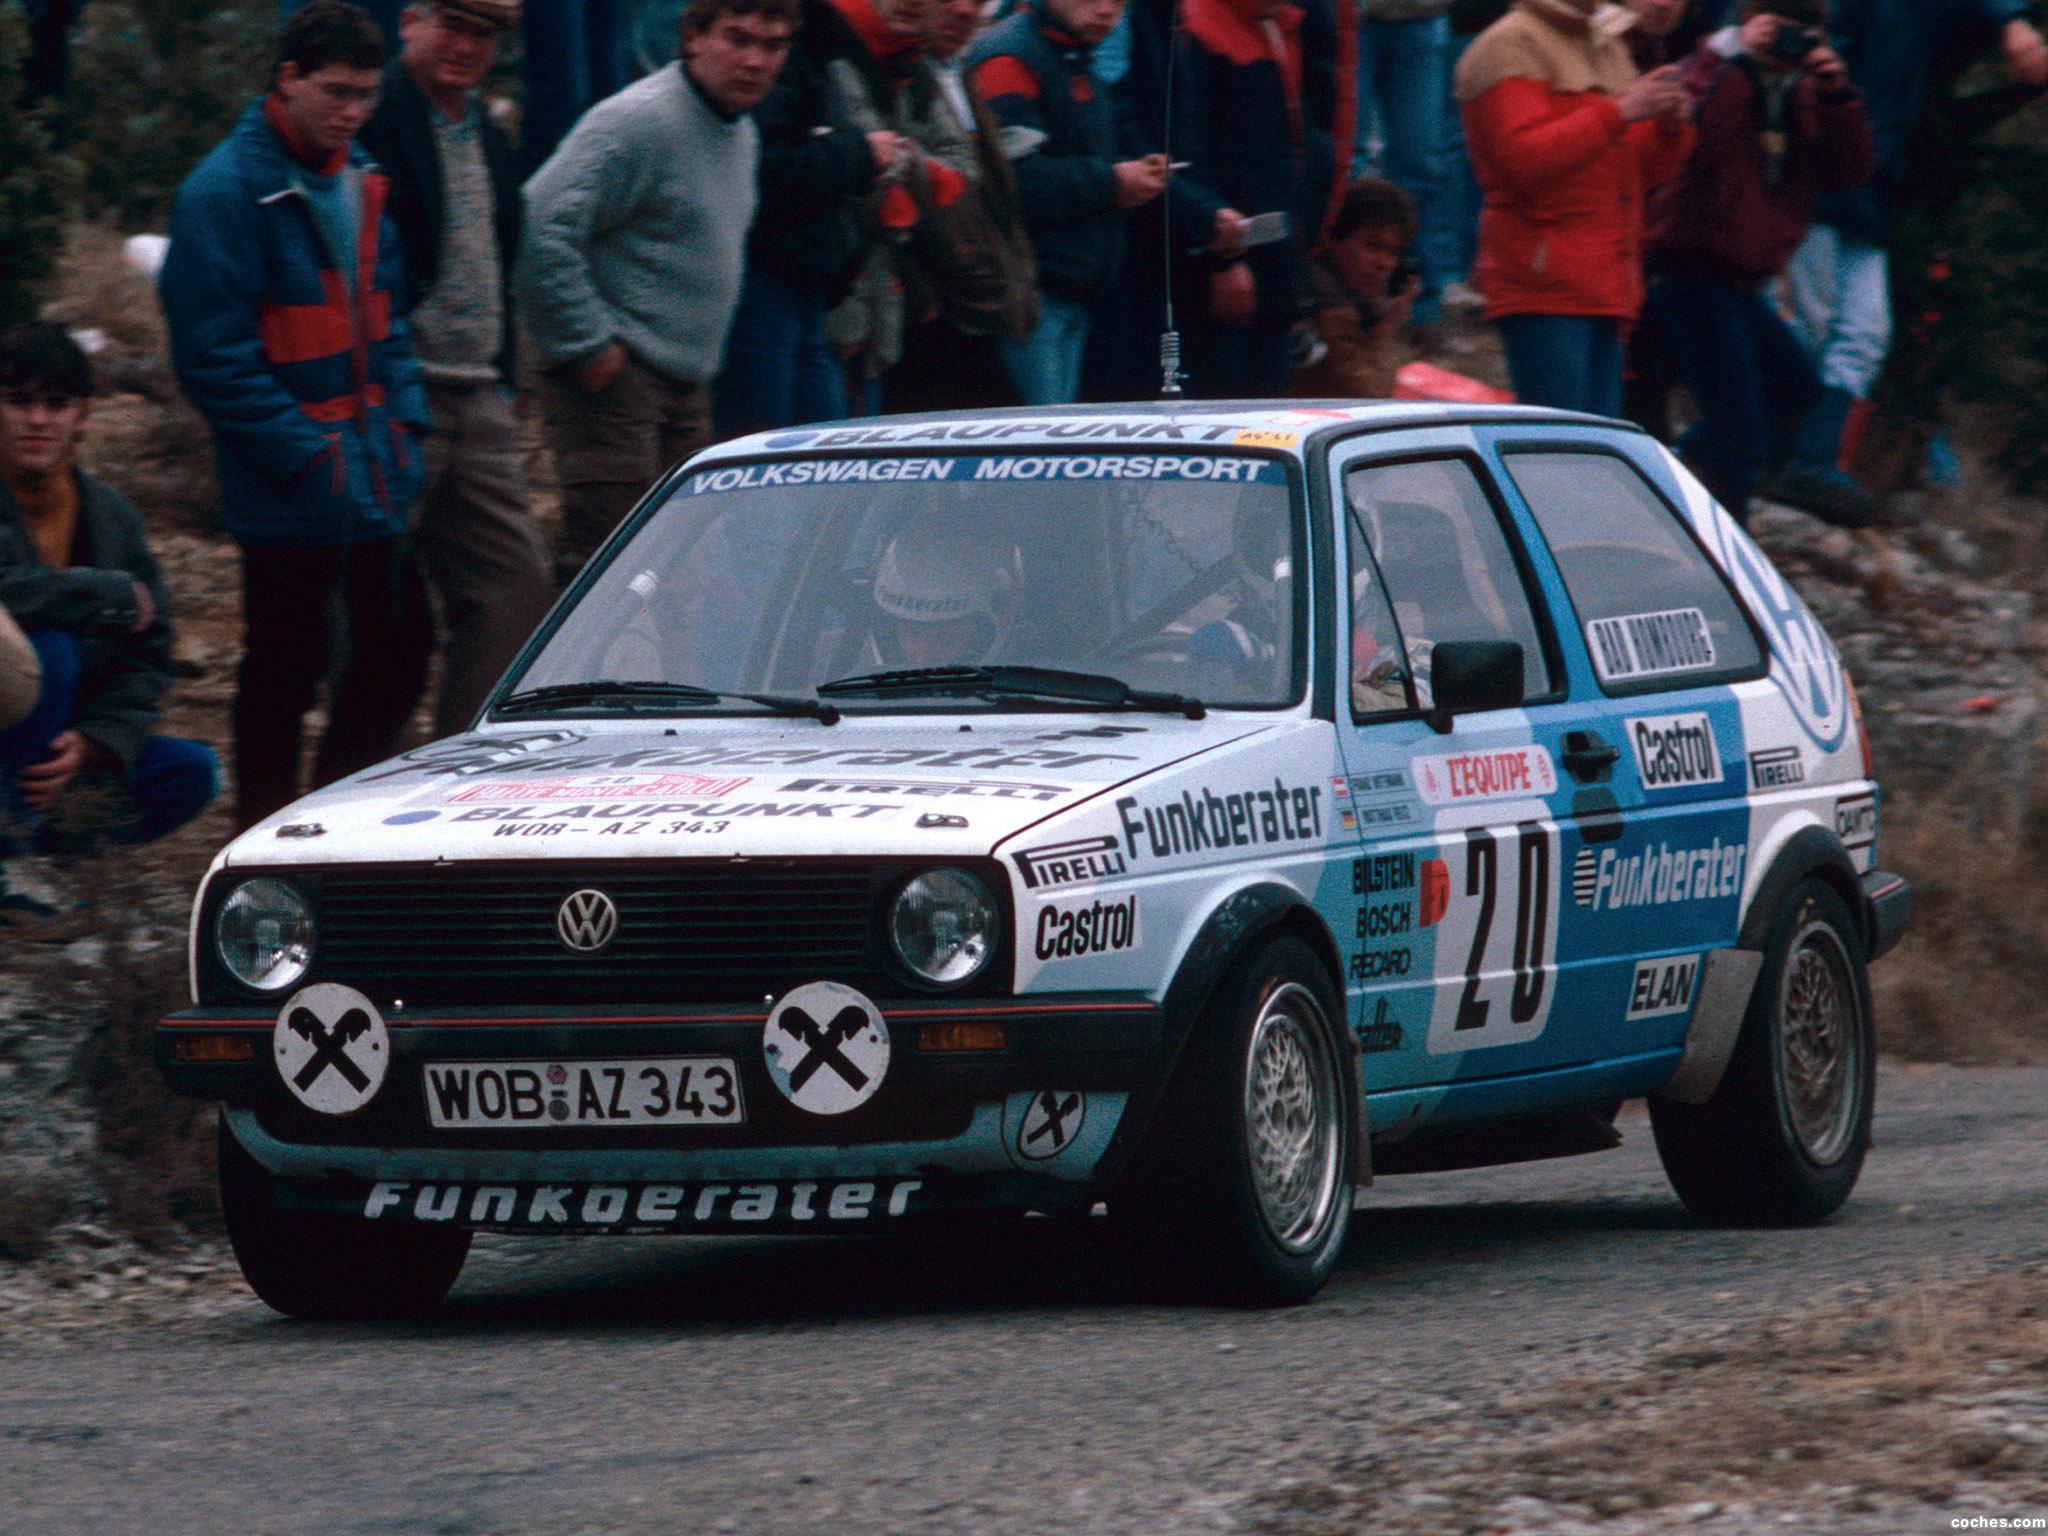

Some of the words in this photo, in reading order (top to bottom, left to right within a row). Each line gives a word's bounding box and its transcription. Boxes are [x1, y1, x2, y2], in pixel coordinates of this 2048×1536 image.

[813, 421, 1242, 447] BLAUPUNKT
[692, 456, 955, 494] VOLKSWAGEN
[974, 456, 1271, 482] MOTORSPORT
[1635, 718, 1715, 785] Castrol
[1748, 745, 1804, 790] PIRELLI
[777, 777, 1074, 802] PIRELLI
[448, 803, 905, 822] BLAUPUNKT
[598, 821, 652, 835] AZ
[659, 820, 731, 835] 343
[1116, 777, 1324, 859] Funkberater
[1011, 834, 1127, 889] PIRELLI
[1353, 852, 1415, 895] BILSTEIN
[1594, 837, 1746, 912] Funkberater
[1035, 895, 1136, 961] Castrol
[1356, 901, 1411, 938] BOSCH
[1455, 820, 1550, 1032] 20
[1350, 948, 1412, 979] RECARO
[1631, 962, 1697, 1013] ELAN
[638, 1065, 736, 1118] 343
